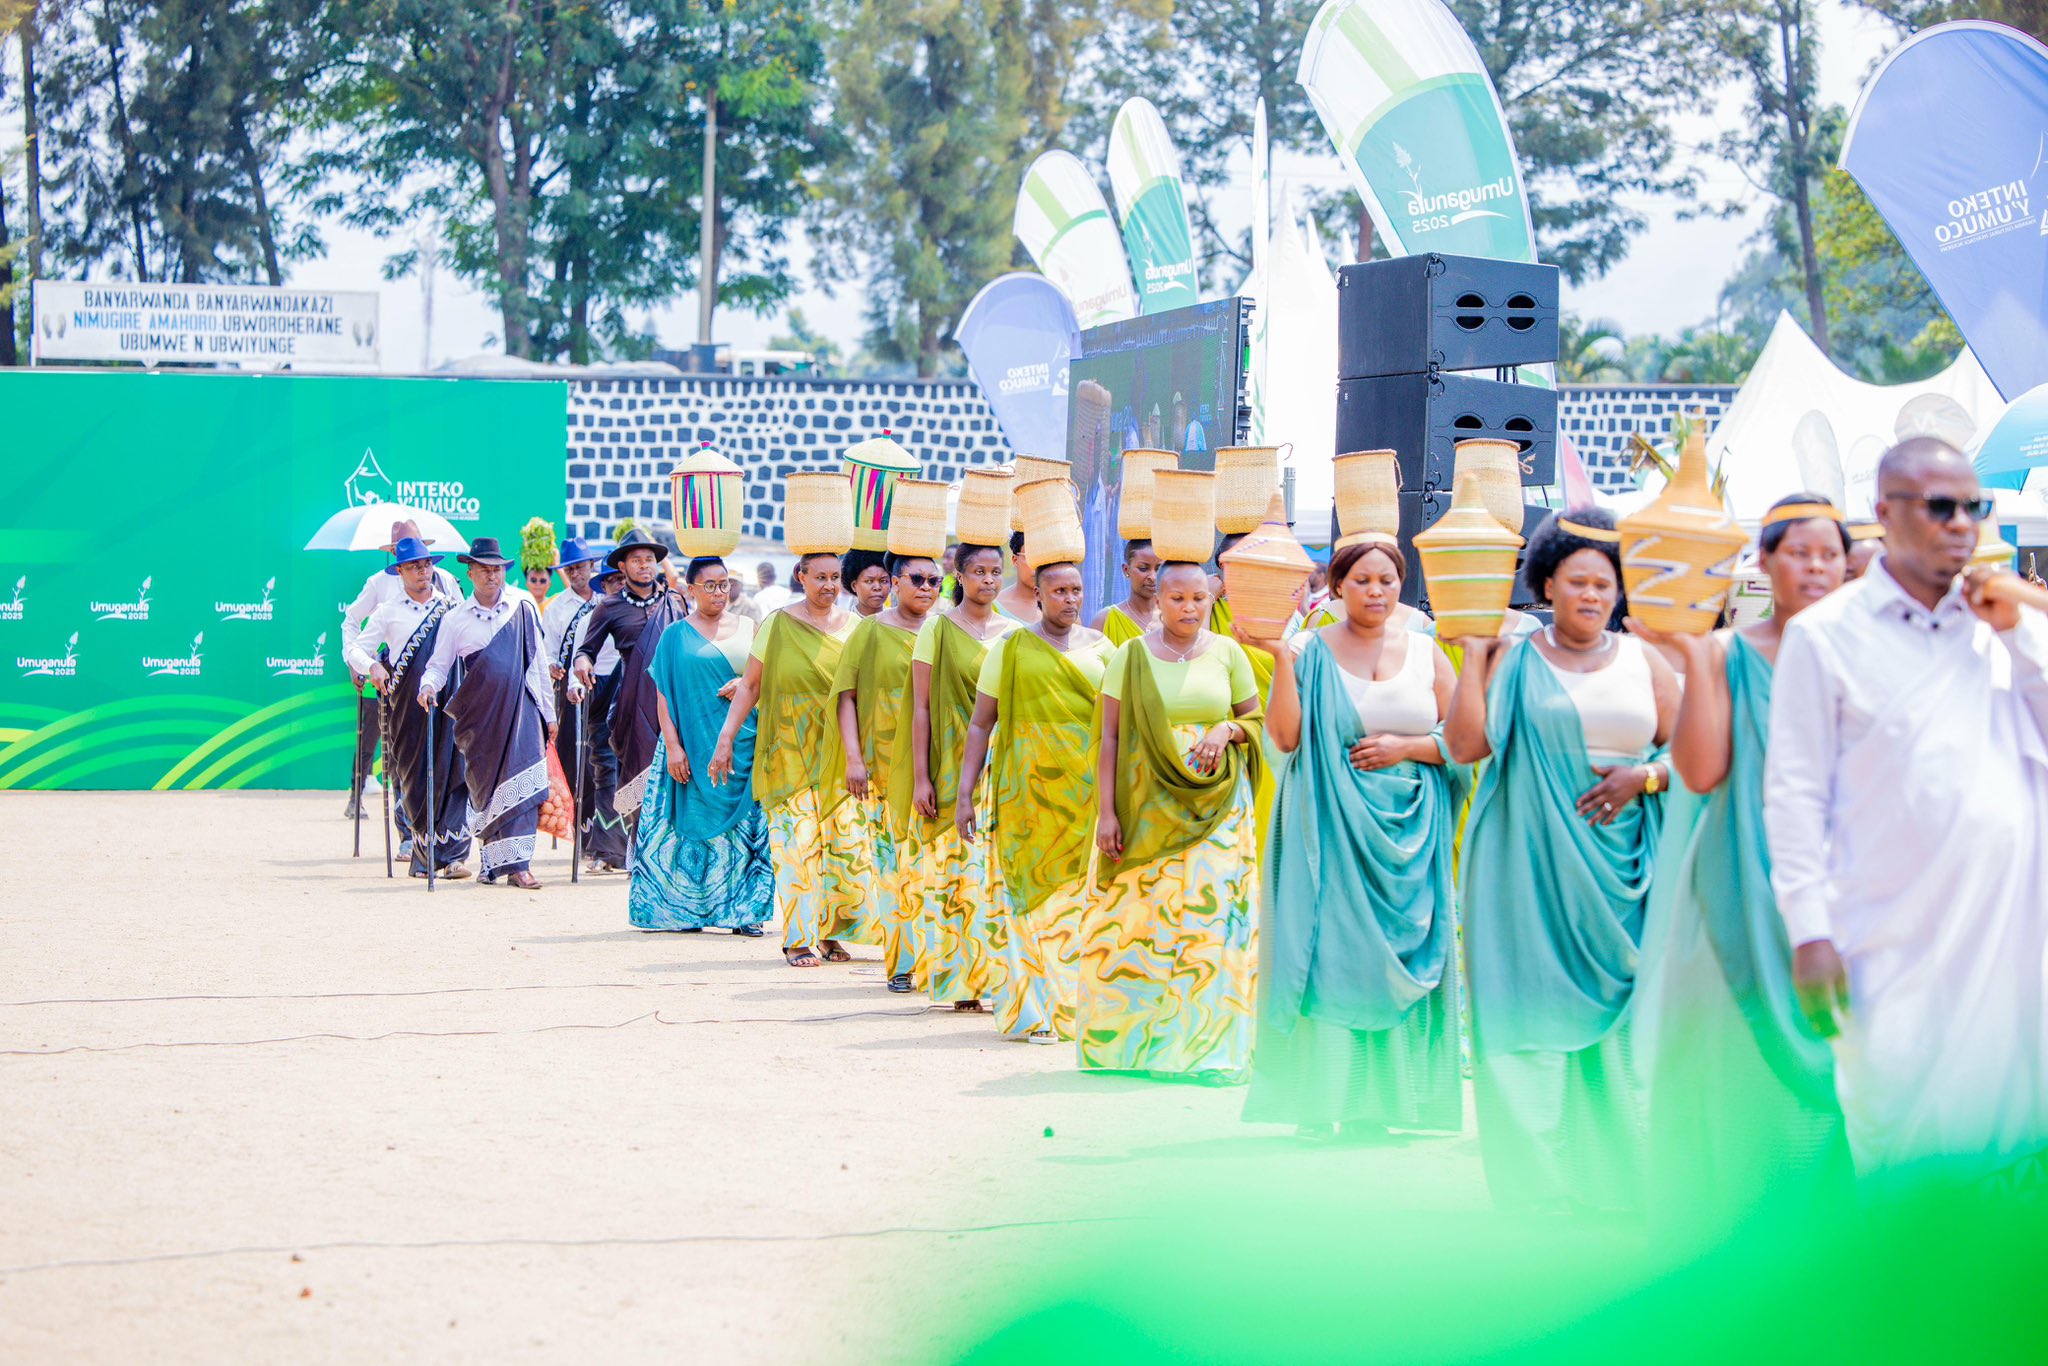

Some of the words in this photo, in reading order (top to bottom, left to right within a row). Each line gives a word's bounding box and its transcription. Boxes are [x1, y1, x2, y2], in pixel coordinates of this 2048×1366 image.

[84, 290, 190, 310] BANYARWANDA
[196, 293, 333, 313] BANYARWANDAKAZI
[74, 311, 141, 330] NIMUGIRE
[222, 315, 343, 335] UBWOROHERANE
[120, 332, 188, 352] UBUMWE
[209, 335, 296, 354] UBWIYUNGE
[397, 481, 464, 498] INTEKO
[2, 612, 23, 620] 2025
[128, 612, 149, 620] 2025
[54, 668, 76, 676] 2025
[303, 668, 324, 676] 2025
